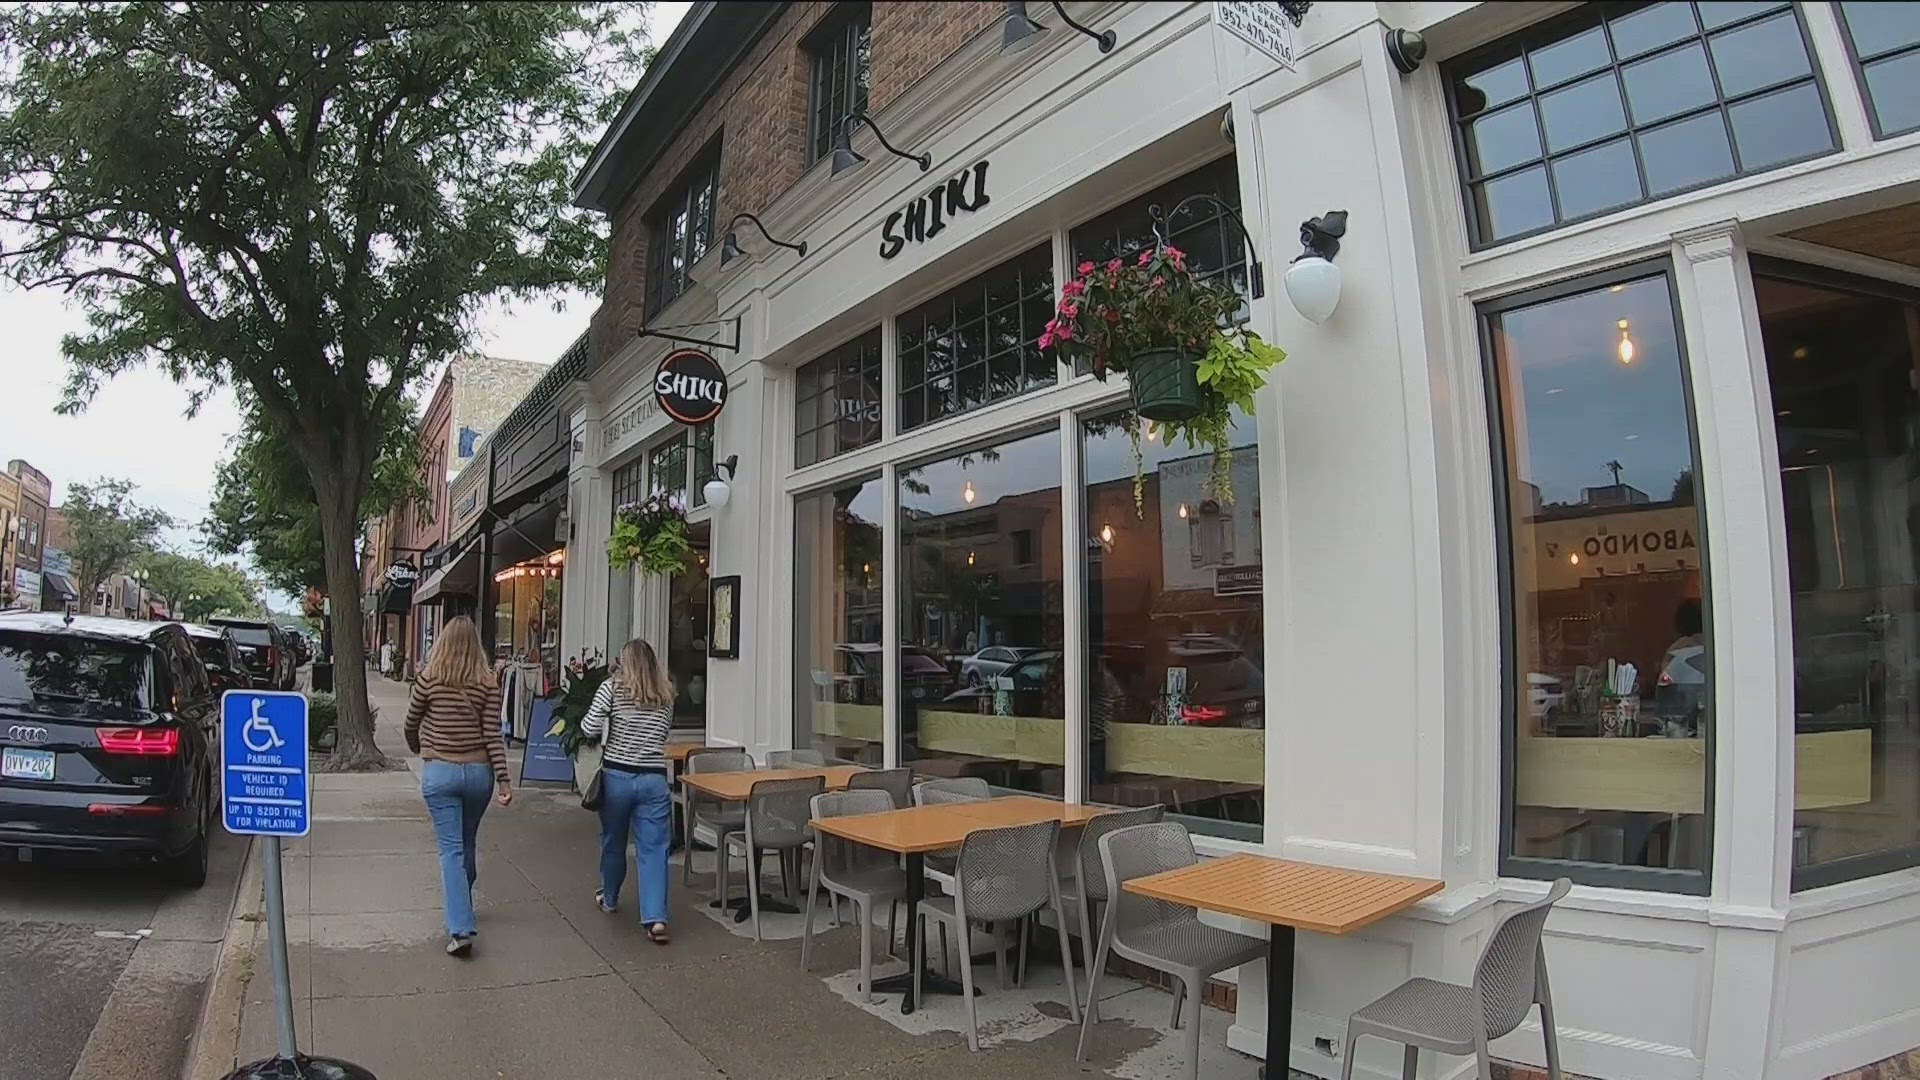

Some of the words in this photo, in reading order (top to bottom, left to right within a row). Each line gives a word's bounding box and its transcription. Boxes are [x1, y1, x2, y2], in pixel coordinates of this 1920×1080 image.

[1229, 2, 1250, 18] OR
[1252, 11, 1281, 38] LEASE
[1257, 3, 1288, 30] SPACE
[1222, 6, 1292, 62] 952-470-7416
[879, 160, 991, 260] SHIKI
[655, 370, 724, 404] SHIKI
[247, 753, 282, 766] PARKING
[242, 774, 275, 784] VEHICLE
[279, 775, 288, 786] ID
[245, 785, 285, 796] REQUIRED
[228, 805, 239, 815] UP
[243, 805, 253, 815] TO
[283, 807, 303, 818] FINE
[236, 817, 252, 826] FOR
[255, 818, 297, 829] VIOLATION
